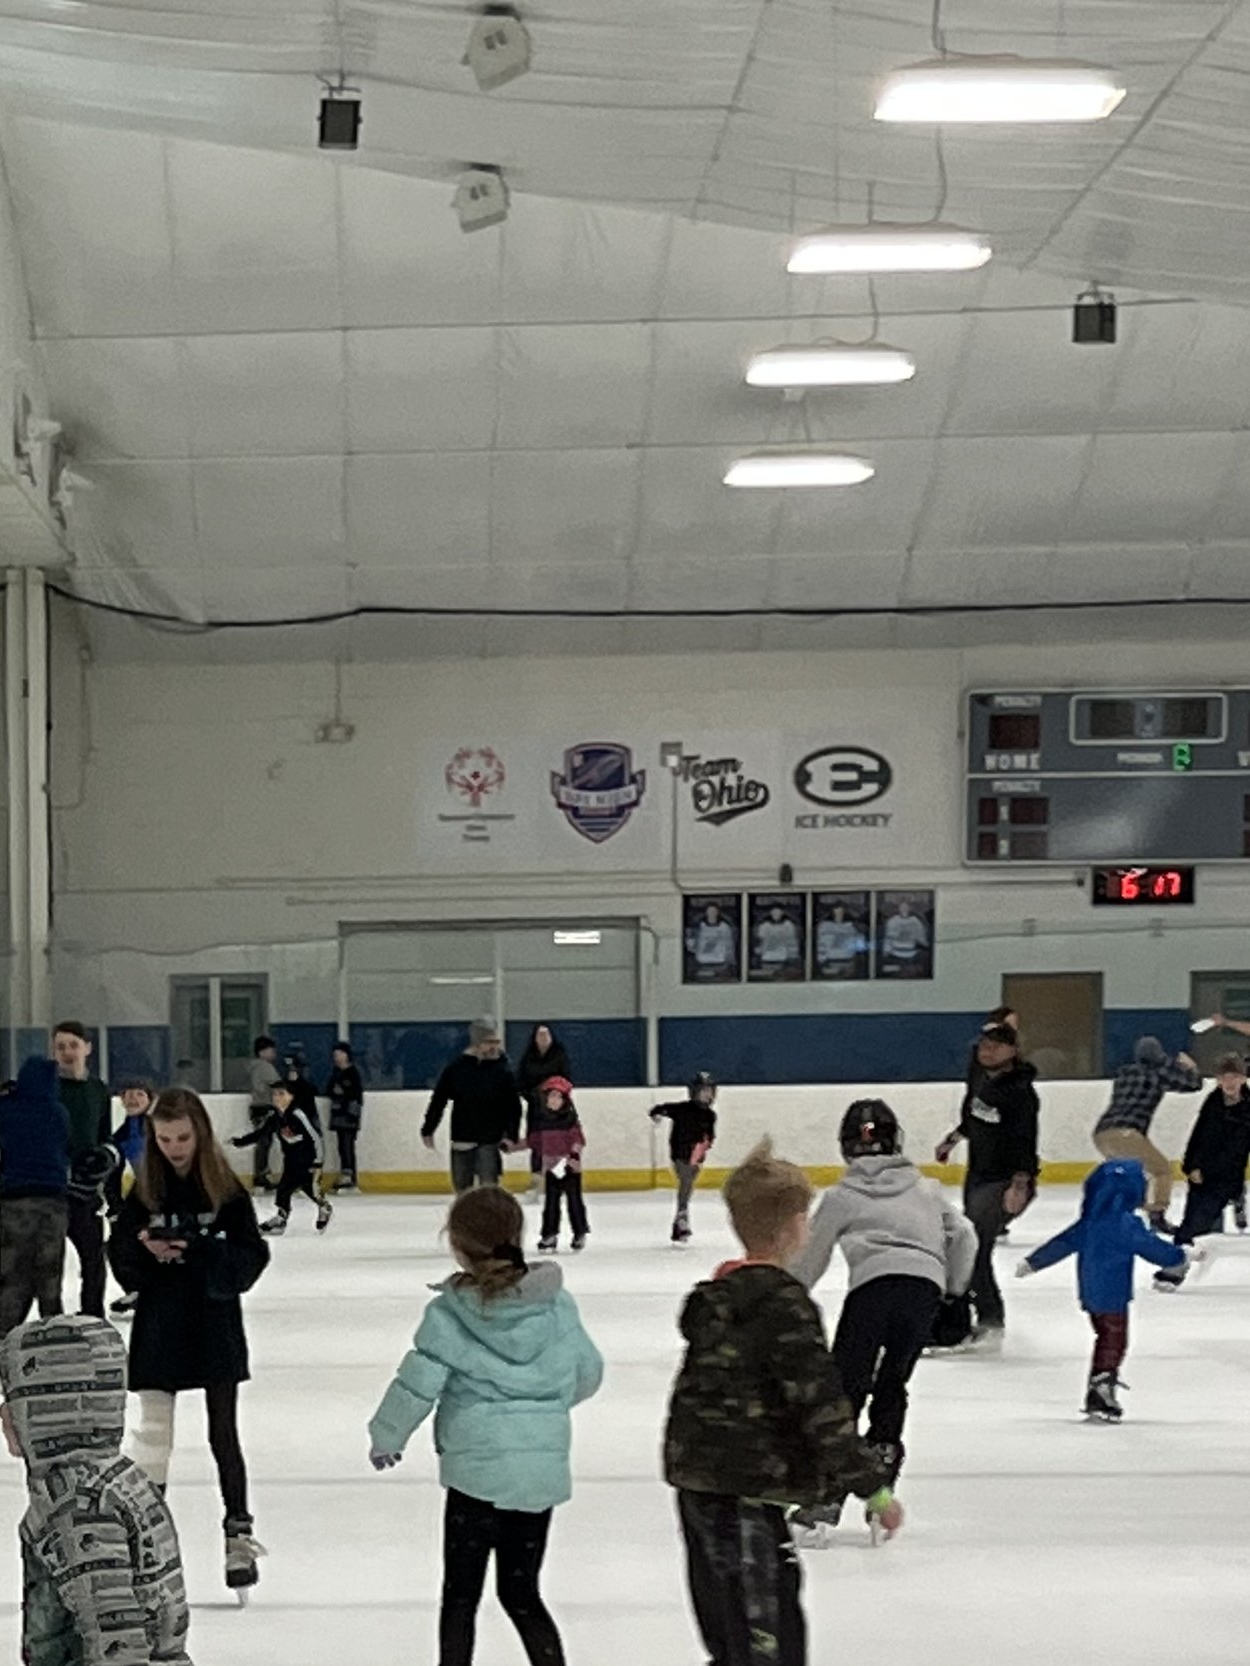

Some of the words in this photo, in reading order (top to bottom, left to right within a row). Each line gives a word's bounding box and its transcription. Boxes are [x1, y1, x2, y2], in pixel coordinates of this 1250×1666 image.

[673, 755, 743, 782] Team
[692, 775, 763, 813] Ohio
[795, 814, 818, 828] ICE
[823, 813, 893, 828] HOCKEY
